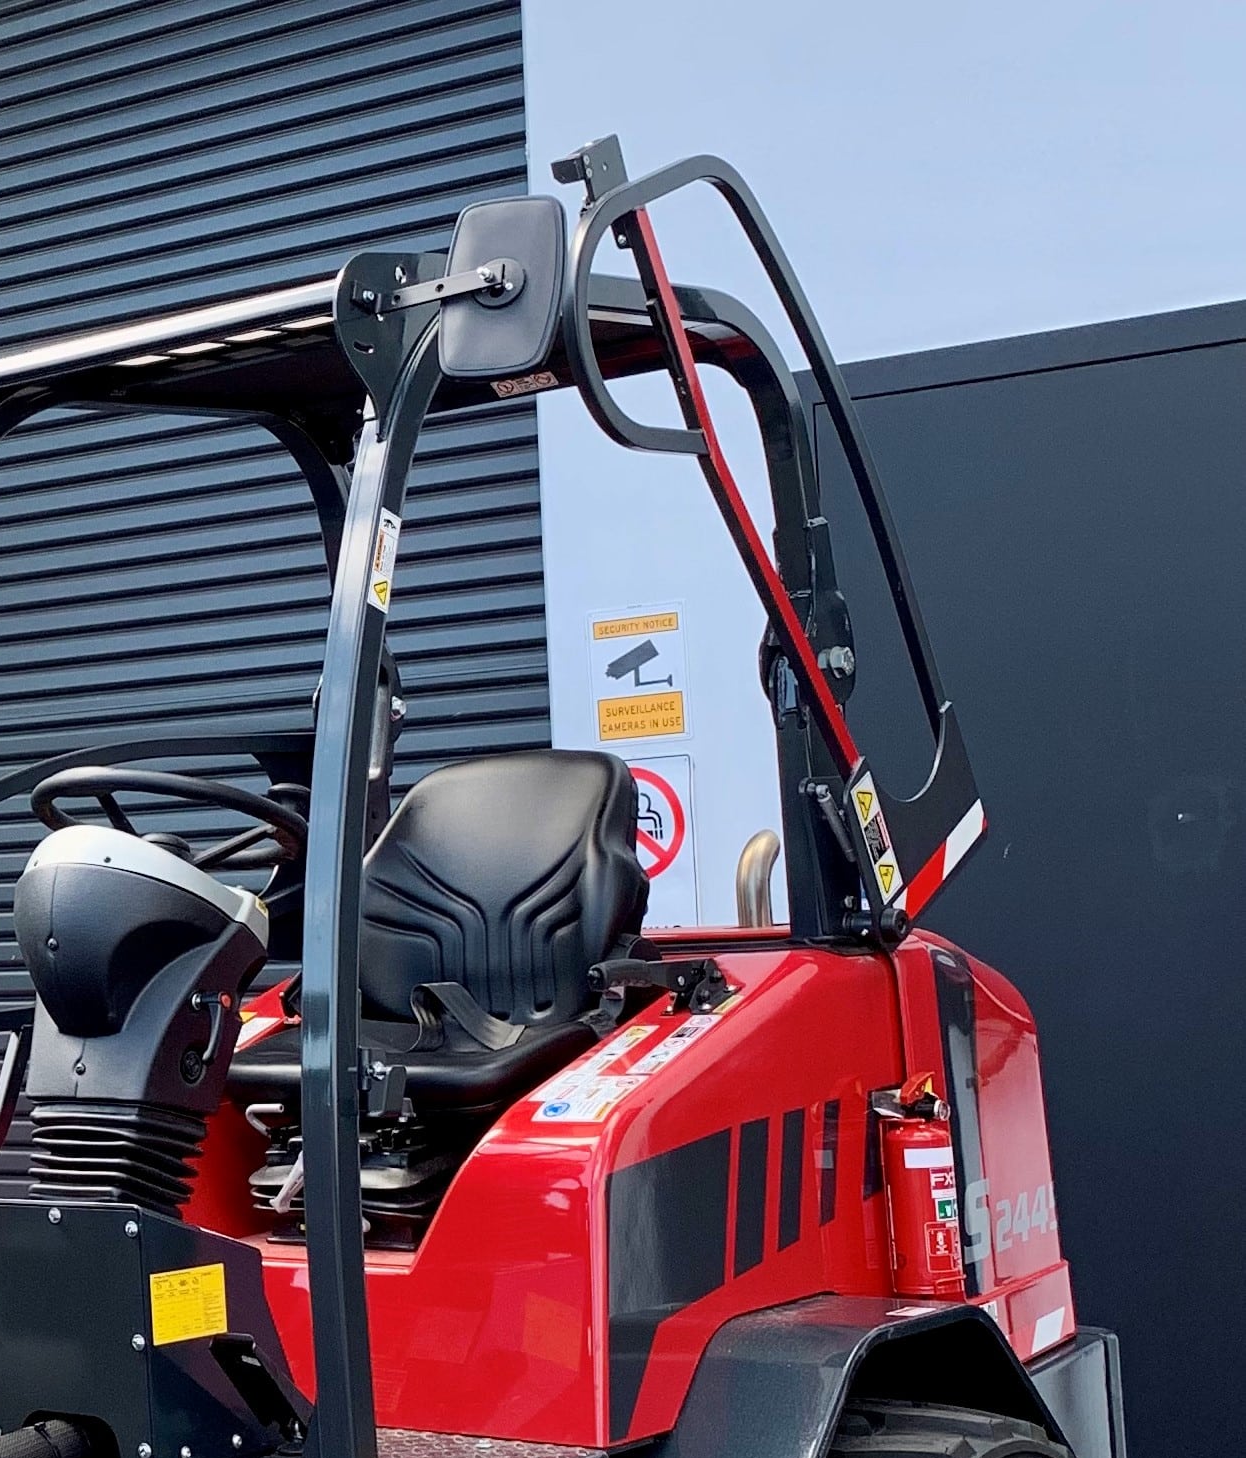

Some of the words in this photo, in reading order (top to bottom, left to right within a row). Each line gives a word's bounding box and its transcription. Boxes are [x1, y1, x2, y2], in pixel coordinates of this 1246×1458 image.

[598, 622, 639, 635] SECURITY
[643, 617, 673, 629] NOTICE
[605, 701, 675, 717] SURVEILLANCE
[601, 720, 646, 733] CAMERAS
[650, 718, 659, 728] IN
[662, 716, 681, 727] USE
[964, 1179, 990, 1265] S
